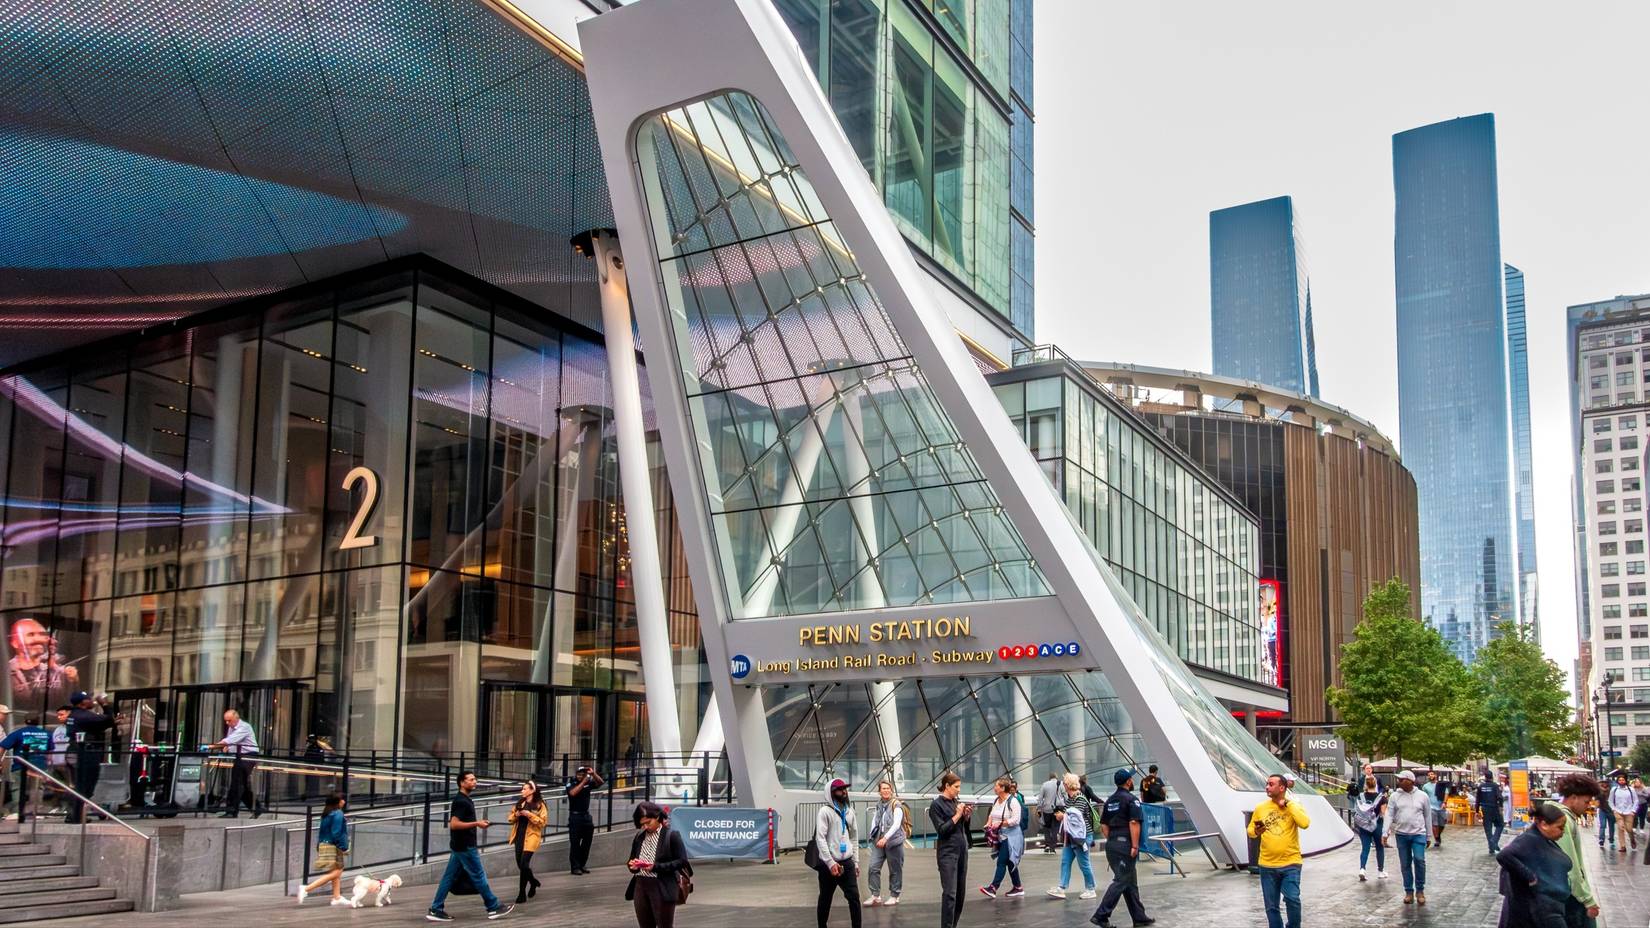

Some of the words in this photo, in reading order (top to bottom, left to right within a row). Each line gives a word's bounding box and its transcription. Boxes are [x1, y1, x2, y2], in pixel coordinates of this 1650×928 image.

[339, 466, 378, 549] 2
[799, 623, 860, 646] PENN
[869, 615, 970, 641] STATION
[731, 659, 747, 674] MTA
[757, 660, 791, 674] Long
[796, 656, 839, 671] Island
[844, 654, 872, 668] Rail
[877, 652, 916, 666] Road
[932, 649, 994, 663] Subway
[1308, 739, 1337, 749] MSG
[694, 819, 733, 829] CLOSED
[735, 820, 755, 829] FOR
[689, 831, 759, 840] MAINTENANCE
